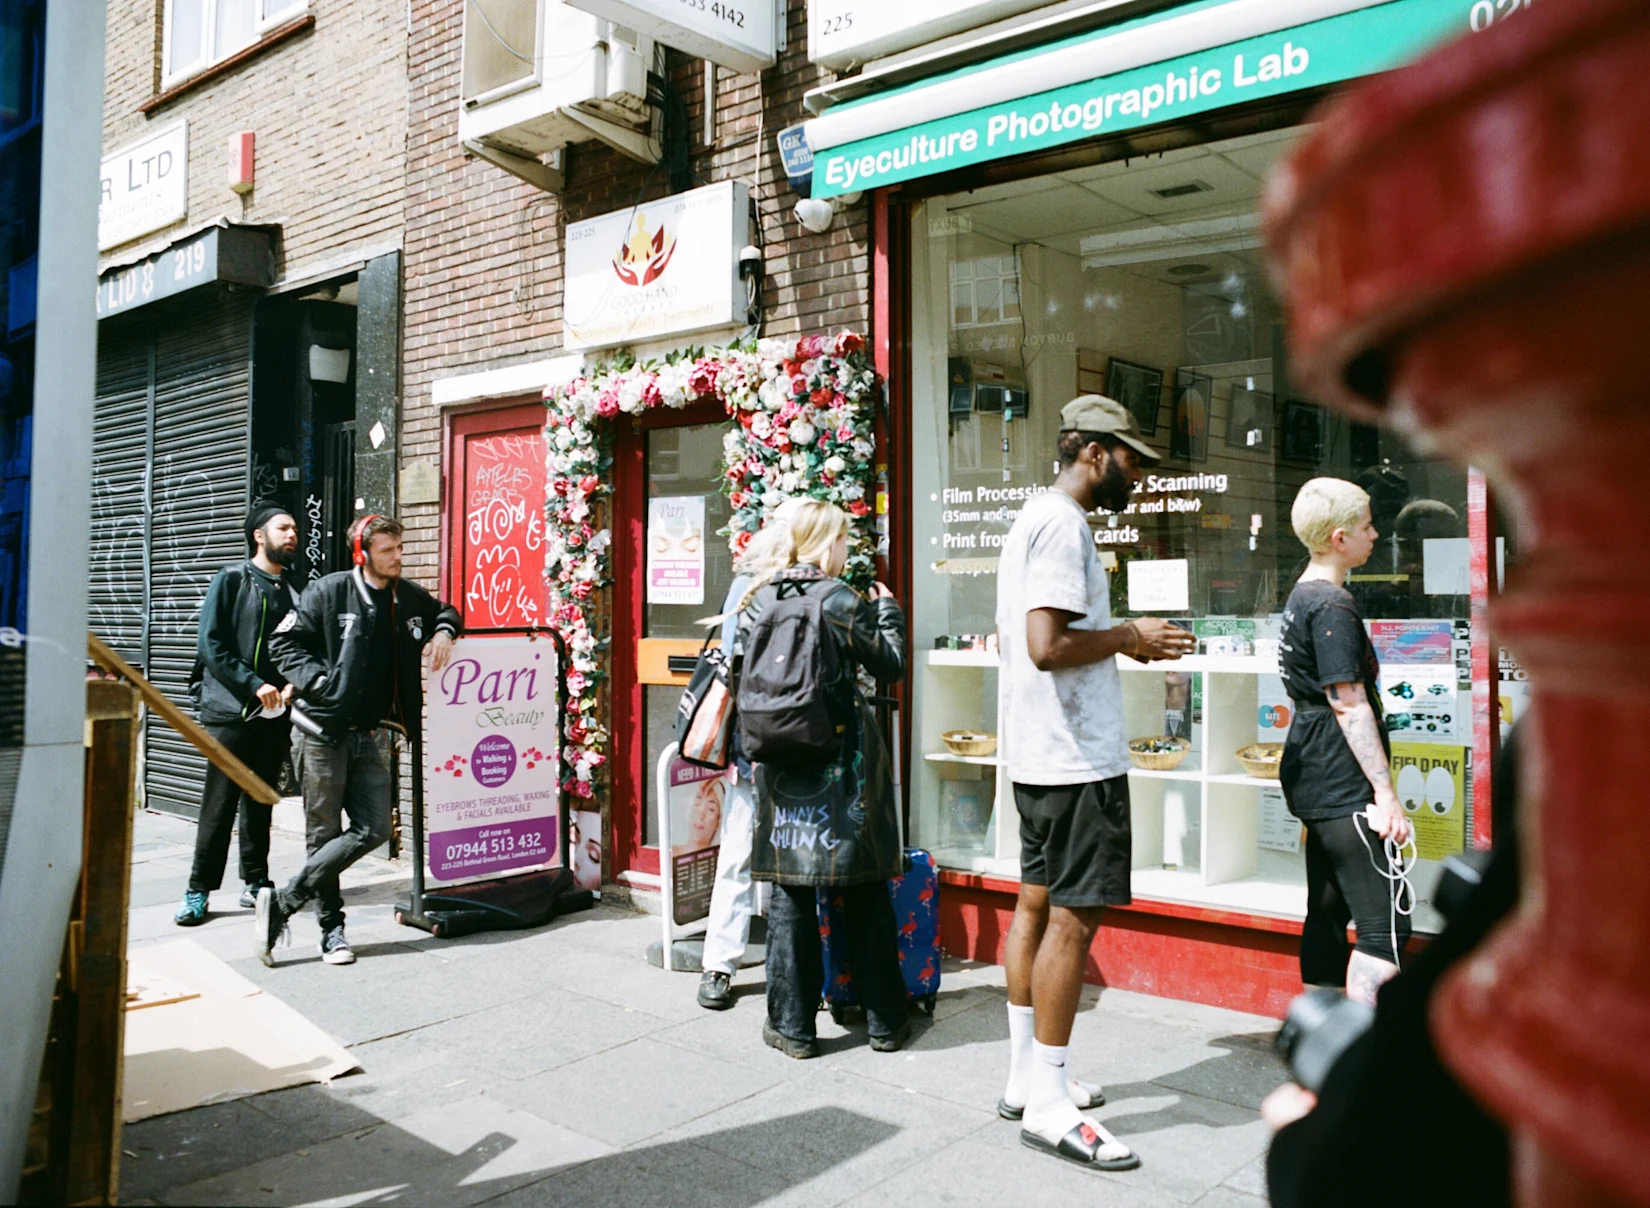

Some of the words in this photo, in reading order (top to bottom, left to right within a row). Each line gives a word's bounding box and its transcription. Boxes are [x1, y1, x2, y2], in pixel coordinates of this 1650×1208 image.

[711, 2, 744, 29] 4142
[823, 13, 853, 36] 225
[825, 127, 979, 188] Eyeculture
[987, 67, 1222, 147] Photographic
[1233, 42, 1309, 87] Lab
[128, 150, 173, 192] LTD
[571, 226, 596, 241] 223-225
[174, 241, 205, 281] 219
[610, 291, 643, 310] GOOD
[645, 284, 678, 303] HAND
[943, 487, 973, 504] Film
[1147, 473, 1228, 493] Scanning
[943, 510, 980, 523] (35mm
[983, 507, 1004, 520] and
[1140, 498, 1164, 513] and
[1167, 498, 1201, 512] b&w)
[943, 533, 976, 548] Print
[1094, 525, 1139, 544] cards
[441, 653, 540, 705] Pari
[476, 706, 544, 730] Beauty
[478, 741, 511, 752] Welcome
[482, 754, 507, 764] Walking
[481, 766, 507, 776] Booking
[677, 766, 695, 782] NEED
[436, 799, 477, 813] EYEBROWS
[524, 790, 550, 802] WAXING
[464, 808, 493, 820] FACIALS
[495, 802, 532, 816] AVAILABLE
[479, 830, 490, 839] Call
[446, 840, 488, 860] 07944
[491, 836, 515, 853] 513
[518, 832, 542, 848] 432
